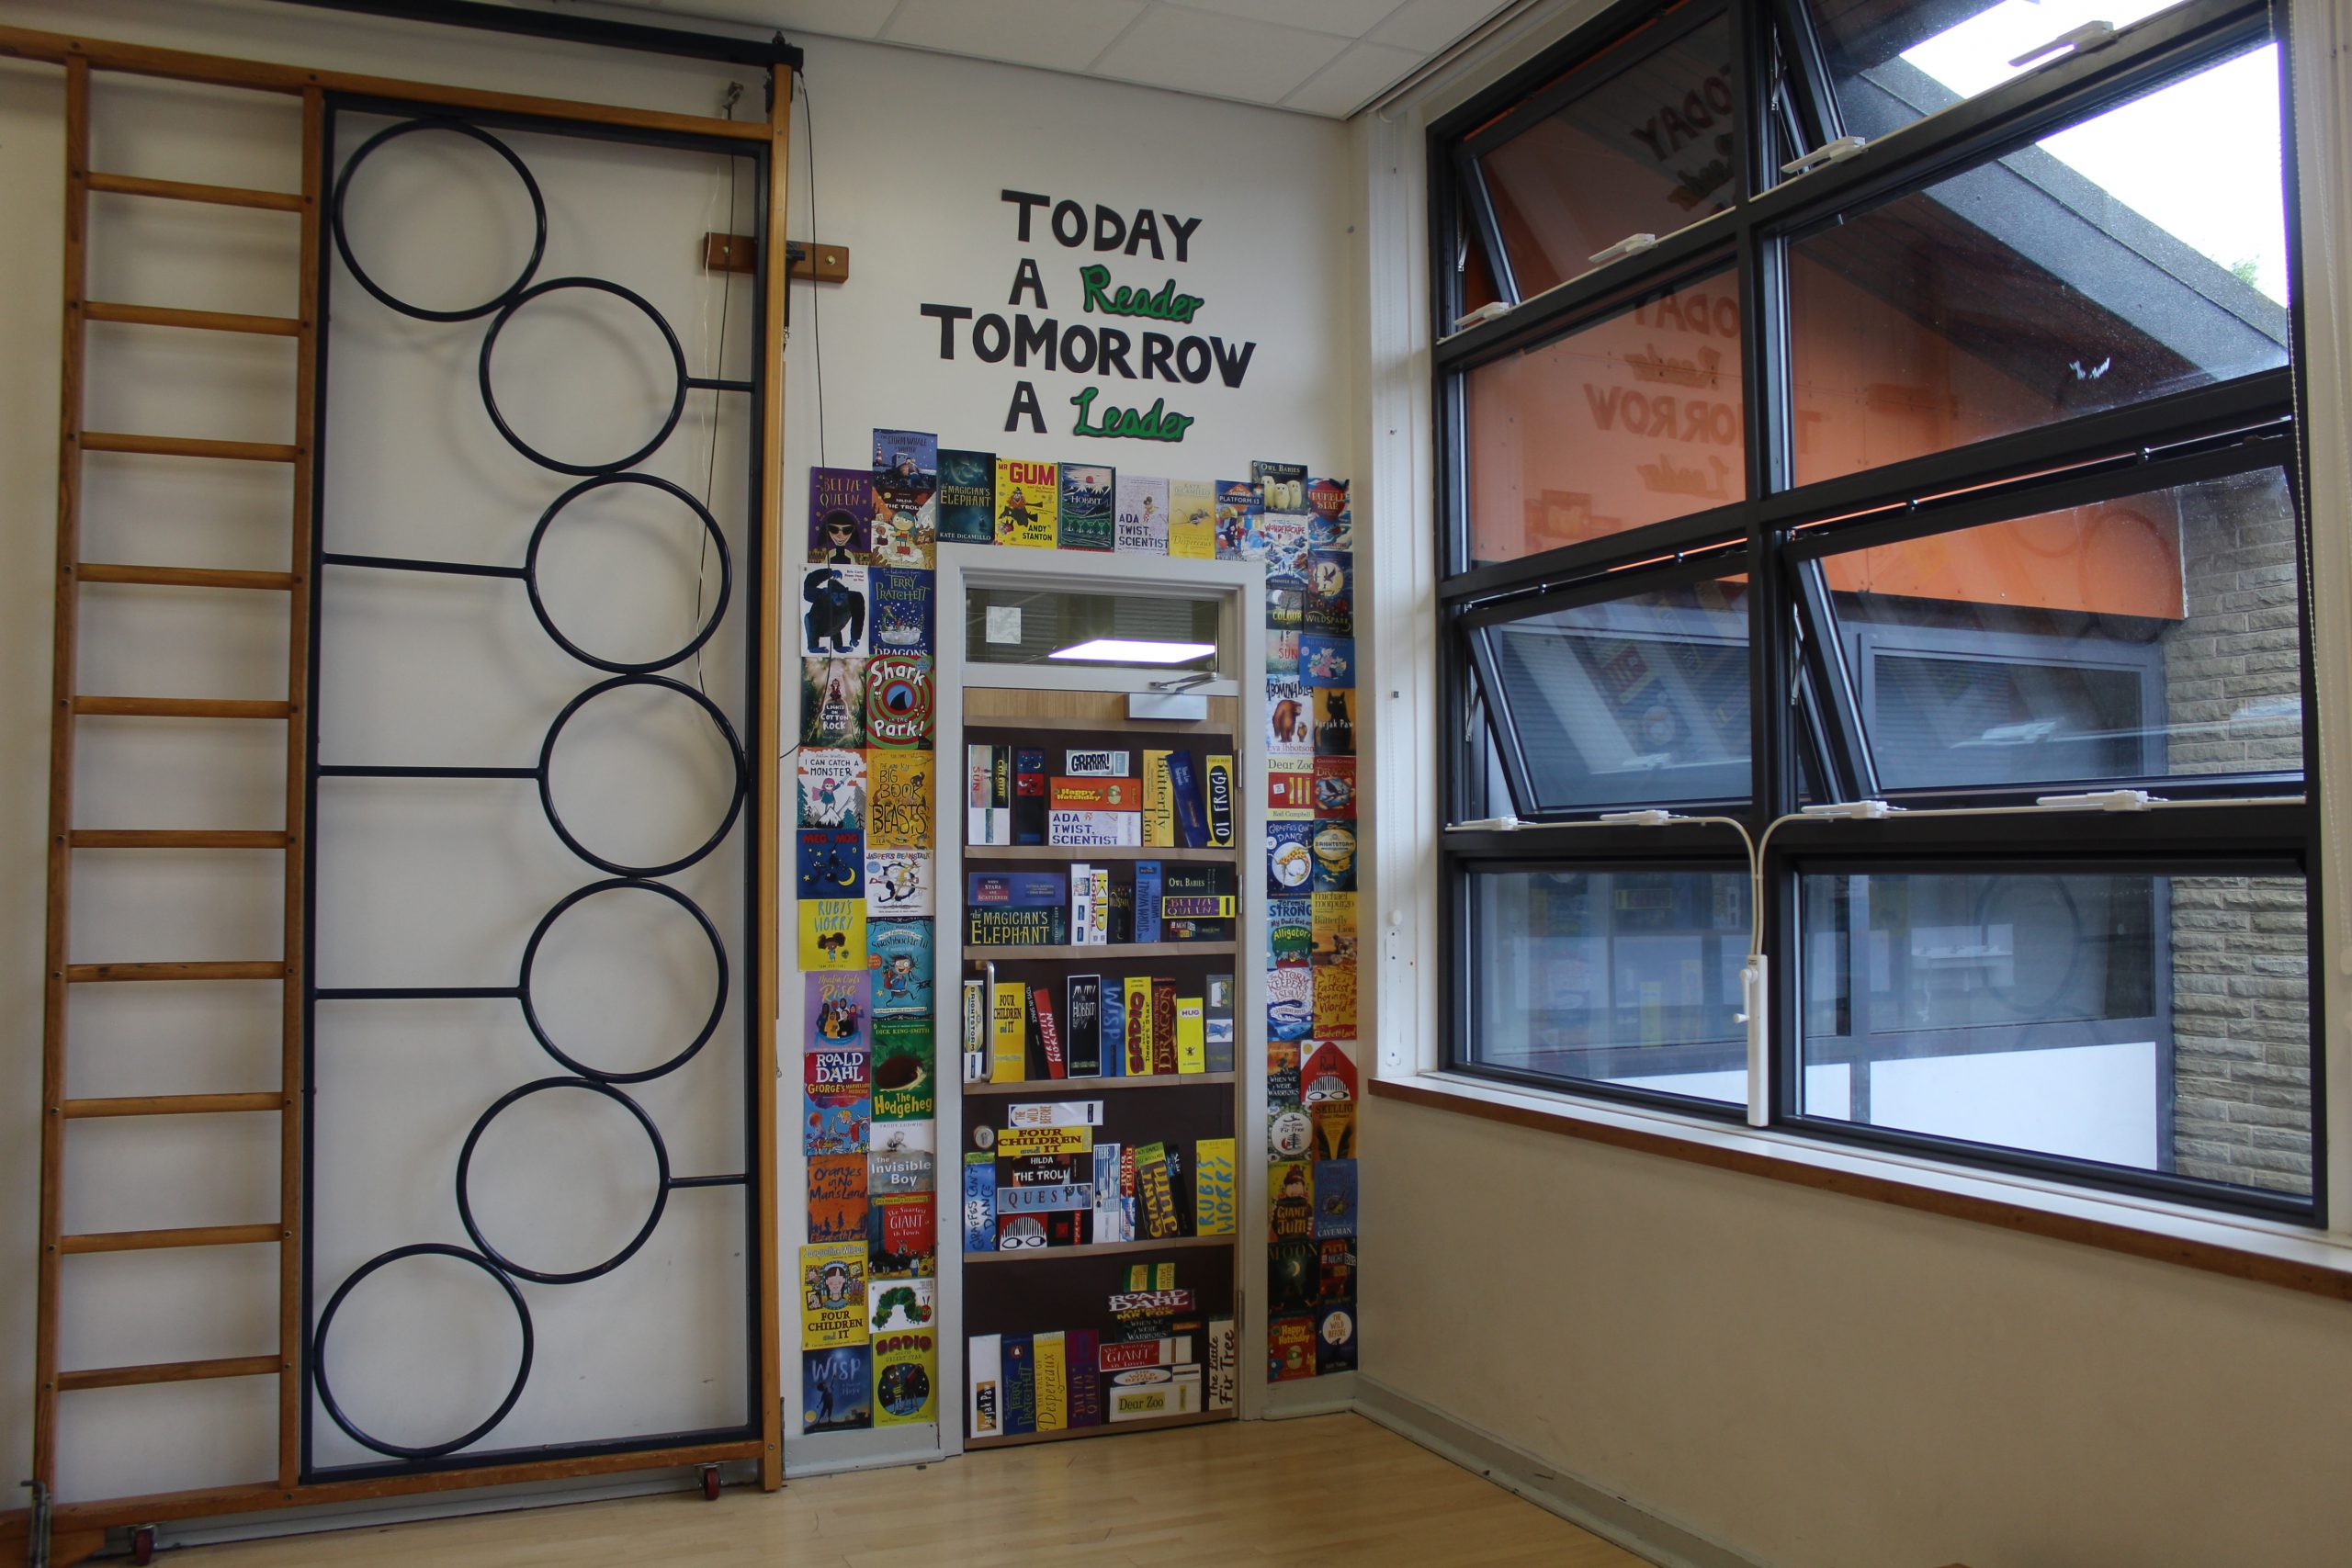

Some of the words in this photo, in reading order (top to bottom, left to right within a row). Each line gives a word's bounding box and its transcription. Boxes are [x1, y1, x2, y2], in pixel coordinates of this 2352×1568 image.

[1001, 189, 1203, 263] TODAY
[1008, 258, 1048, 310] A
[1080, 264, 1204, 323] Reader
[921, 303, 1257, 389] TOMORROW
[1004, 380, 1047, 434] A
[1070, 387, 1194, 442] Leader
[1010, 462, 1056, 486] GUM
[1261, 463, 1276, 471] OWL
[1278, 465, 1301, 473] BABIES
[947, 485, 990, 496] MAGICIAN'S
[819, 492, 860, 508] QUEEN
[940, 490, 991, 508] ELEPHANT
[1071, 495, 1102, 504] HOBBIT
[1219, 496, 1252, 504] PLATFORM
[1118, 513, 1140, 524] ADA
[1264, 523, 1306, 535] WONDERSCAPE
[1023, 532, 1053, 542] STANTON
[1118, 536, 1169, 549] SCIENTIST
[885, 574, 917, 590] TERRY
[876, 581, 932, 602] PRATCHETT
[1272, 611, 1303, 623] COLOUR
[1278, 647, 1299, 660] SUN
[870, 660, 926, 687] Shark
[823, 721, 846, 730] ROCK
[874, 719, 925, 738] Park!
[1268, 758, 1295, 770] Dear
[810, 768, 853, 777] MONSTER
[879, 770, 899, 784] BIG
[972, 765, 981, 791] SUN
[997, 759, 1006, 797] COLOUR
[880, 784, 922, 799] BOOK
[1057, 794, 1101, 802] Hatchday
[1061, 788, 1096, 796] Happy
[1157, 756, 1170, 829] Butterfly
[1210, 772, 1229, 812] FROG!
[873, 803, 928, 836] BEASTS
[1053, 813, 1080, 822] ADA
[1144, 808, 1157, 842] Lion
[1052, 835, 1118, 845] SCIENTIST
[1277, 832, 1303, 842] DANCE
[1169, 877, 1183, 887] OWL
[1185, 877, 1205, 886] BABIES
[818, 900, 853, 916] RUBY'S
[1096, 873, 1108, 931] KID
[983, 910, 1048, 925] MAGICIAN'S
[1167, 907, 1212, 917] QUEEN
[1269, 904, 1312, 917] STRONG
[814, 917, 854, 932] WORRY
[1315, 915, 1348, 925] Butterfly
[971, 919, 1050, 945] ELEPHANT
[1278, 969, 1310, 983] STORM
[820, 984, 856, 1002] Rise
[1274, 988, 1307, 1001] ISLAND
[1317, 983, 1351, 992] Fastest
[999, 994, 1015, 1007] FOUR
[1319, 1003, 1348, 1013] World
[993, 1007, 1022, 1020] CHILDREN
[1029, 1007, 1037, 1024] SPACE
[1008, 1021, 1014, 1033] IT
[1159, 987, 1172, 1073] DRAGON
[1046, 1013, 1062, 1063] NORMAN
[816, 1052, 864, 1067] ROALD
[816, 1066, 864, 1083] DAHL
[808, 1083, 845, 1094] GEORGE'S
[896, 1093, 910, 1102] The
[874, 1096, 933, 1118] Hodgeheg
[1027, 1108, 1038, 1123] WILD
[998, 1135, 1082, 1146] CHILDREN
[1017, 1128, 1063, 1138] FOUR
[1044, 1145, 1060, 1154] IT
[872, 1160, 932, 1174] Invisible
[1030, 1156, 1054, 1165] HILDA
[814, 1167, 862, 1181] Oranges
[891, 1173, 918, 1187] Boy
[1014, 1171, 1035, 1181] THE
[1036, 1169, 1069, 1180] TROLL
[842, 1185, 868, 1200] Land
[1008, 1188, 1072, 1209] QUEST
[1215, 1156, 1235, 1232] WORRY
[980, 1184, 995, 1230] DANCE
[1140, 1169, 1162, 1238] GIANT
[889, 1214, 923, 1229] GIANT
[967, 1201, 984, 1250] GIRAFFES
[1108, 1289, 1188, 1303] ROALD
[1108, 1296, 1189, 1312] DAHL
[820, 1310, 851, 1321] FOUR
[808, 1318, 863, 1331] CHILDREN
[838, 1329, 850, 1339] IT
[1126, 1331, 1167, 1341] WARRIORS
[1106, 1349, 1150, 1363] GIANT
[1208, 1335, 1218, 1371] Little
[1220, 1330, 1236, 1371] Tree
[1036, 1353, 1063, 1431] Despereaux
[1208, 1374, 1218, 1398] The
[1218, 1374, 1234, 1405] Fir
[1009, 1378, 1022, 1410] TERRY
[1017, 1362, 1035, 1426] PRATCHETT
[1119, 1398, 1144, 1411] Dear
[1146, 1395, 1164, 1408] Zoo
